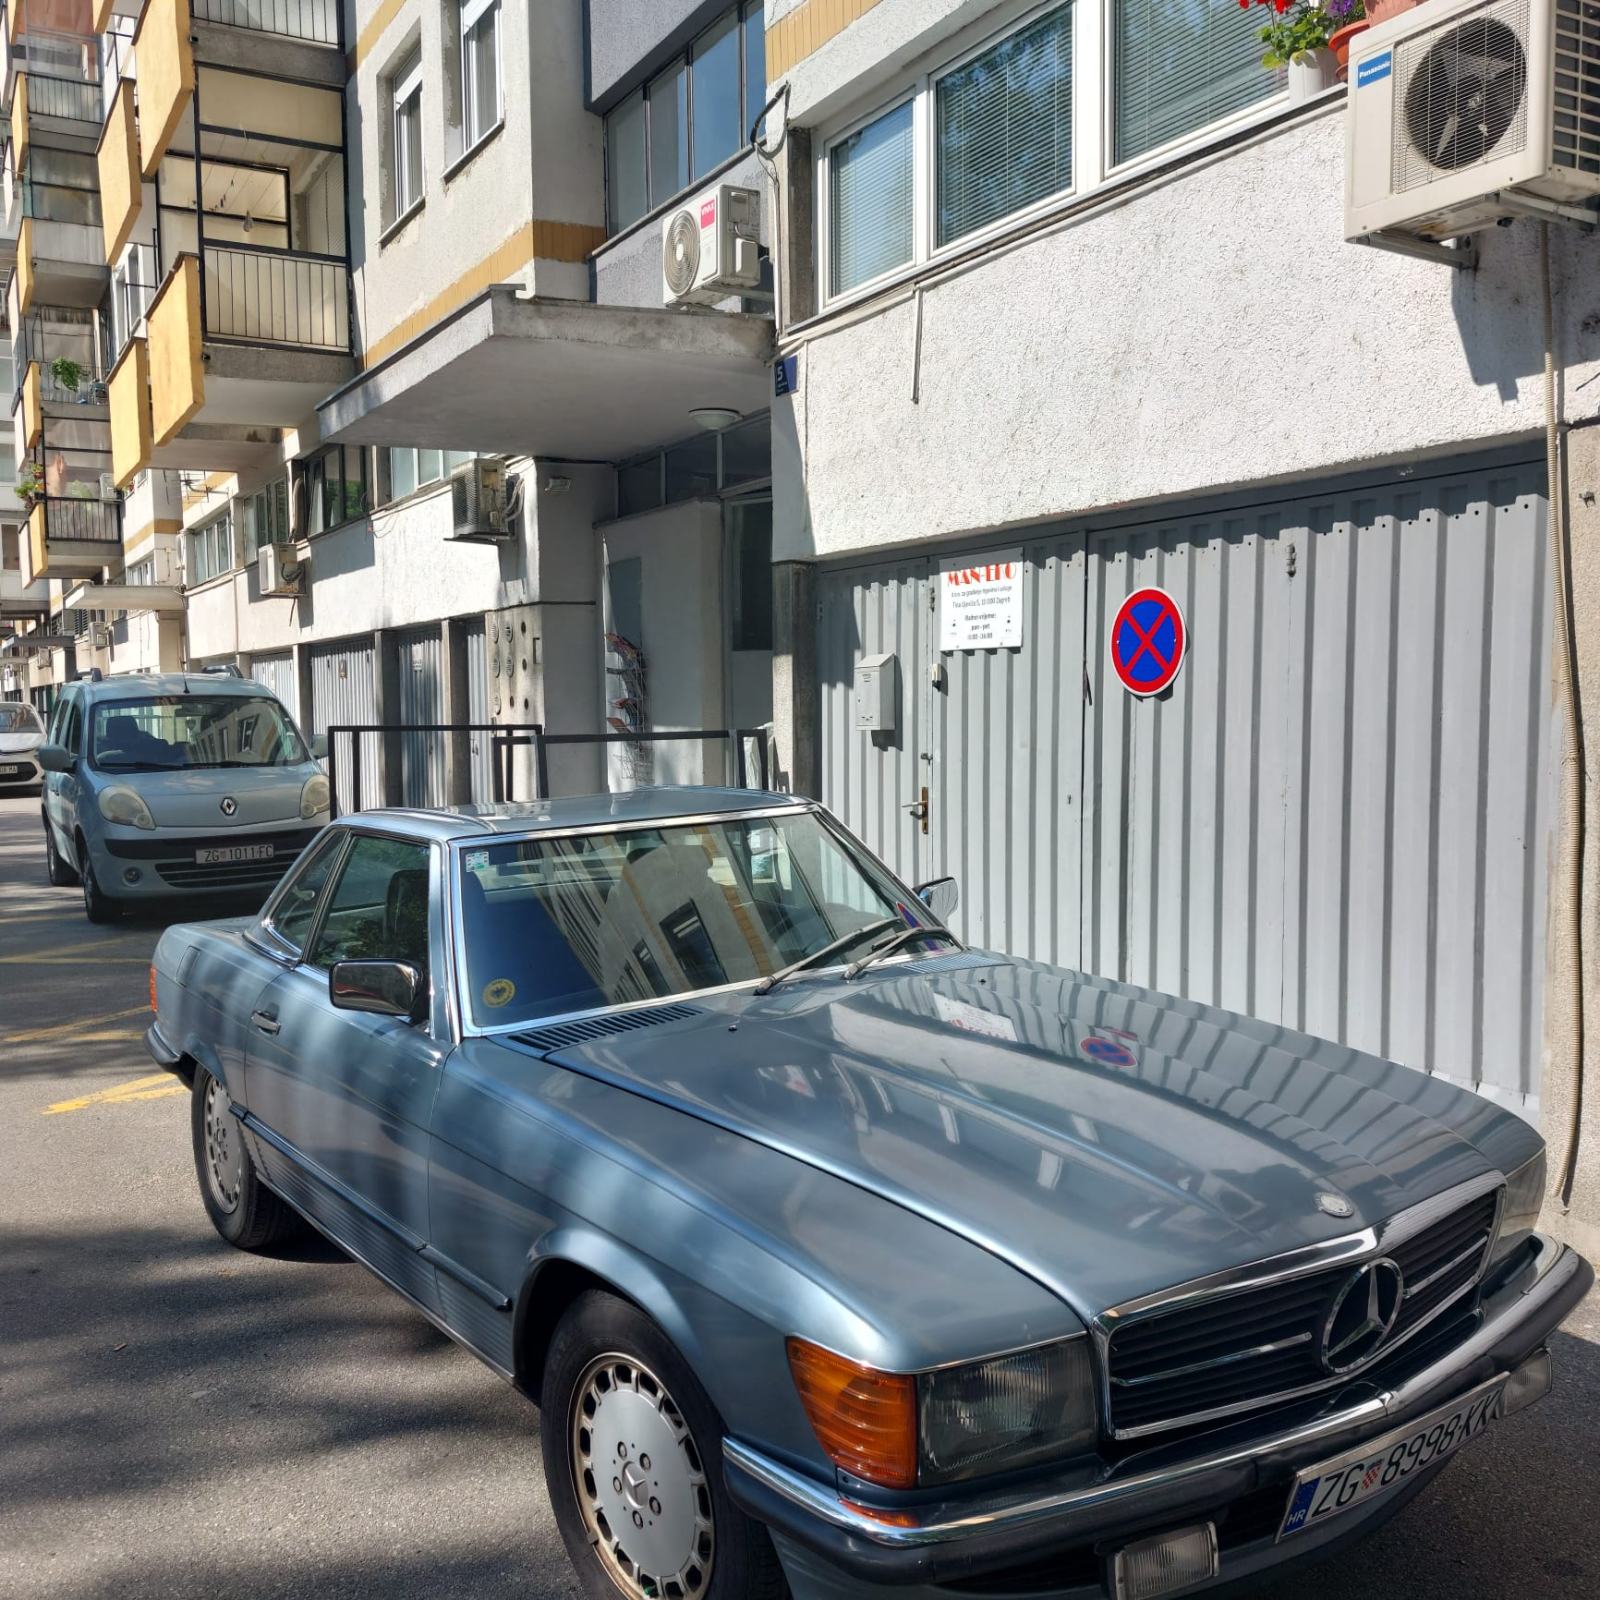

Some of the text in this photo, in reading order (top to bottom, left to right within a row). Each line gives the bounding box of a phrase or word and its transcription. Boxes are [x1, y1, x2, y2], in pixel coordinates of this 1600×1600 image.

[1359, 60, 1391, 79] Panasonic
[777, 365, 784, 382] 5
[204, 850, 220, 862] ZG
[1311, 1463, 1365, 1518] ZG
[1286, 1508, 1306, 1526] HR
